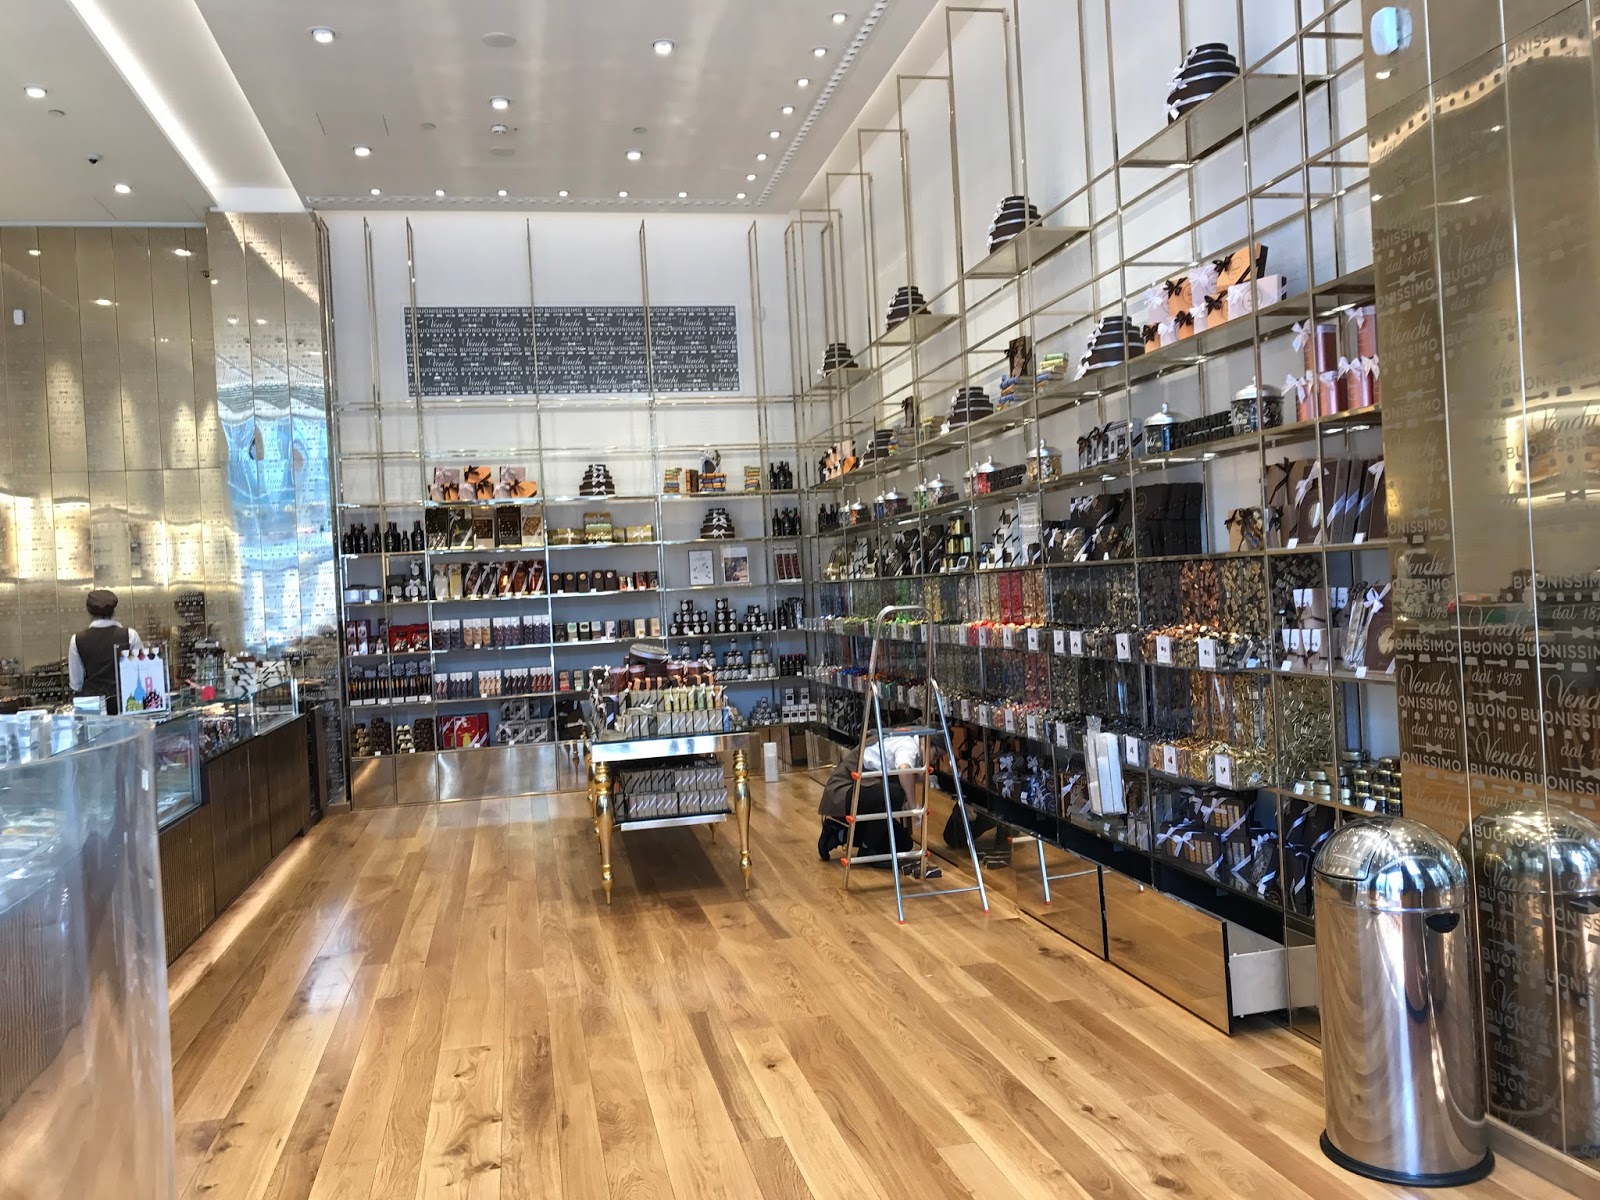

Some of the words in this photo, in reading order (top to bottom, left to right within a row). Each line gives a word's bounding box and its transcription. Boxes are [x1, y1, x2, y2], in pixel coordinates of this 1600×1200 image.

[1408, 248, 1429, 267] 1878
[1377, 278, 1435, 308] ONISSIMO
[1443, 259, 1494, 285] BUONO
[462, 337, 488, 347] Venchi
[590, 336, 615, 346] Venchi
[1380, 311, 1432, 348] Venchi
[558, 356, 583, 365] Venchi
[621, 356, 645, 365] Venchi
[1380, 338, 1438, 364] ONISSIMO
[592, 375, 617, 384] Venchi
[1415, 367, 1435, 383] 1878
[1531, 400, 1600, 432] Venchi
[1389, 517, 1447, 534] ONISSIMO
[1393, 549, 1445, 575] Venchi
[1426, 607, 1448, 619] 1878
[1469, 606, 1527, 638] Venchi
[1552, 606, 1577, 620] dal
[1395, 639, 1453, 652] ONISSIMO
[1463, 640, 1514, 656] BUONO
[1400, 664, 1452, 695] Venchi
[1472, 669, 1492, 684] dal
[1497, 673, 1522, 686] 1878
[1399, 695, 1457, 713] ONISSIMO
[1467, 702, 1517, 720] BUONO
[1411, 722, 1429, 737] dal
[1433, 726, 1456, 740] 1878
[1475, 731, 1536, 770] Venchi
[1560, 743, 1585, 759] dal
[1401, 751, 1461, 772] ONISSIMO
[1470, 763, 1521, 784] BUONO
[1478, 793, 1499, 809] dal
[1474, 824, 1525, 848] BUONO
[1492, 979, 1552, 1028] Venchi
